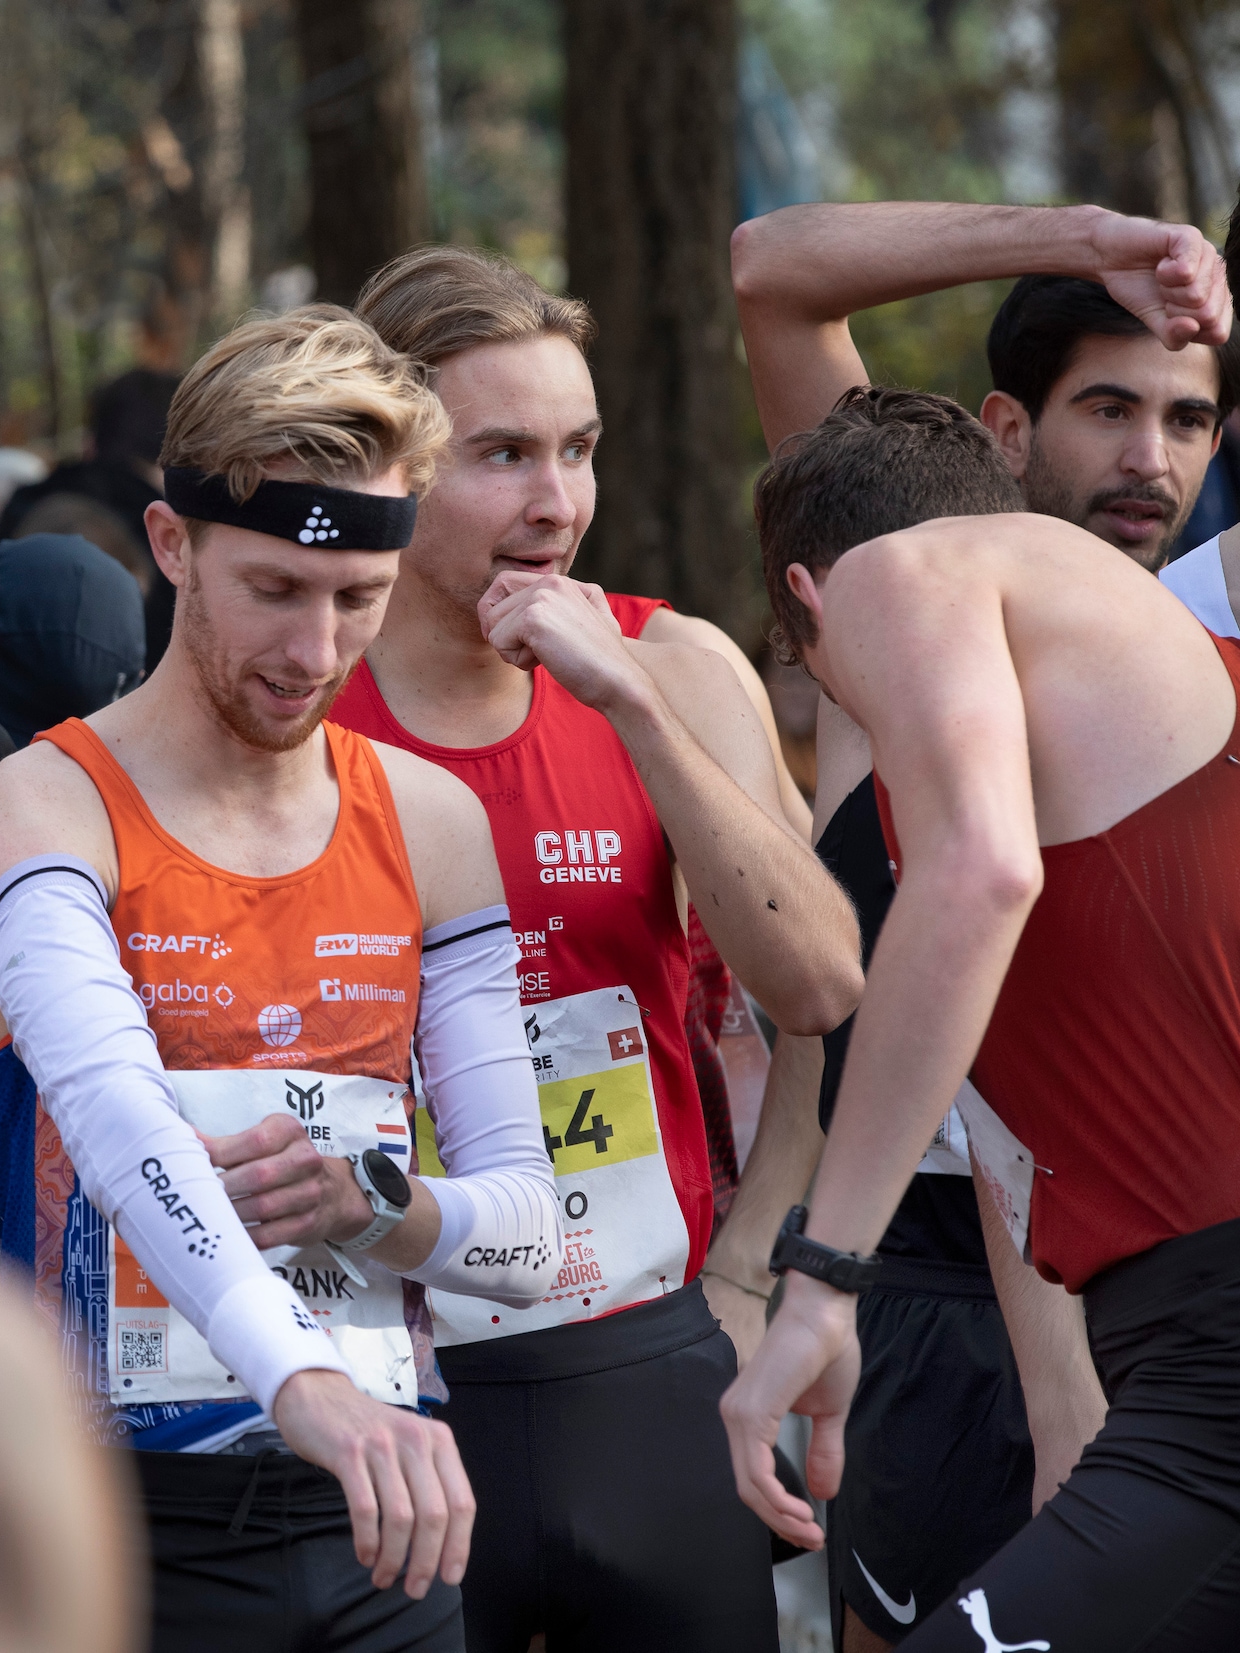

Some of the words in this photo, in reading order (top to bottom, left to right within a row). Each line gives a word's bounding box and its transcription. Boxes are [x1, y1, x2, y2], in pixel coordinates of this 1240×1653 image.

[534, 830, 622, 865] CHP
[540, 866, 622, 884] GENEVE
[127, 932, 212, 954] CRAFT
[359, 934, 412, 946] RUNNERS
[360, 945, 400, 956] WORLD
[139, 978, 209, 1009] gaba
[344, 984, 406, 1003] Milliman
[158, 1008, 179, 1016] Goed
[141, 1157, 206, 1235] CRAFT
[464, 1245, 535, 1267] CRAFT
[125, 1320, 160, 1330] UITSLAG
